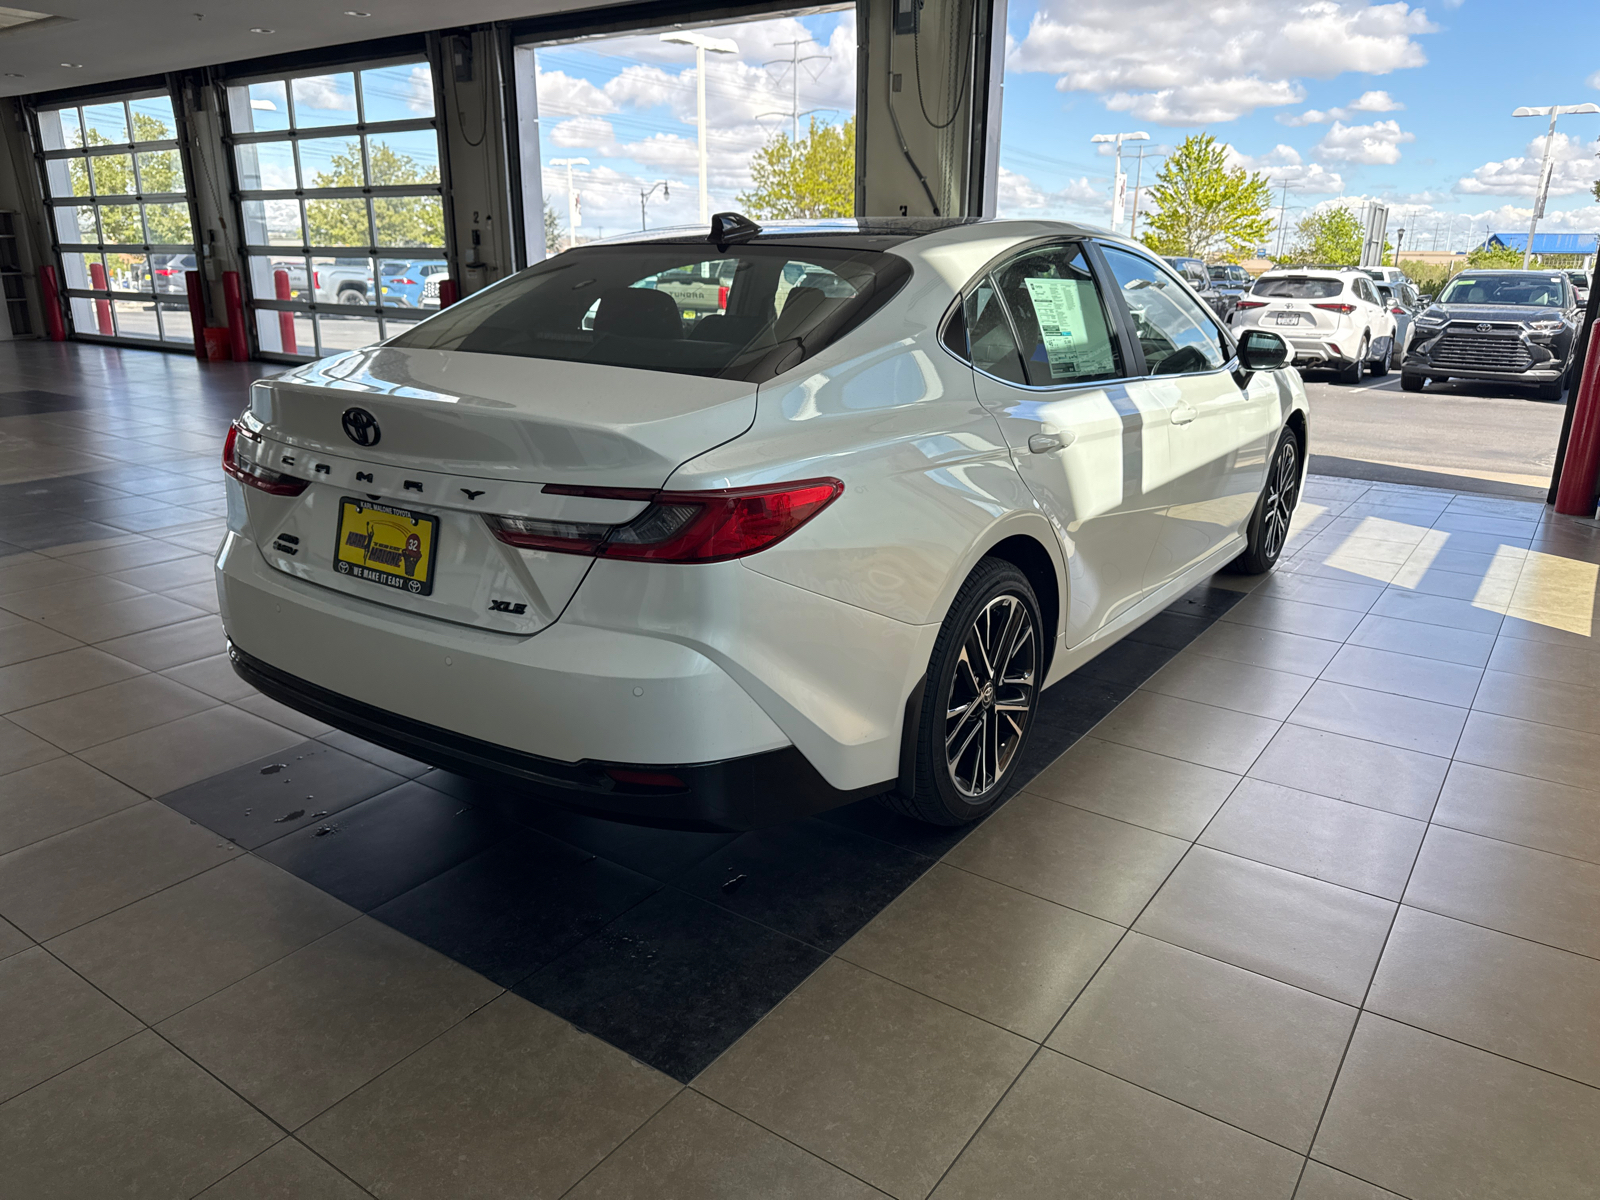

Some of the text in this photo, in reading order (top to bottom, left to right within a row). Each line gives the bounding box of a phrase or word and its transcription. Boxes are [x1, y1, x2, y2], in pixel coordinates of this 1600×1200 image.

[473, 211, 479, 223] 2
[669, 291, 705, 299] TUNDRA
[281, 455, 486, 500] CAMRY
[360, 501, 412, 518] KARL MALONE TOYOTA
[408, 539, 418, 552] 32
[368, 547, 402, 568] MALONE
[353, 566, 404, 588] WE MAKE IT EASY
[488, 599, 528, 615] XLE
